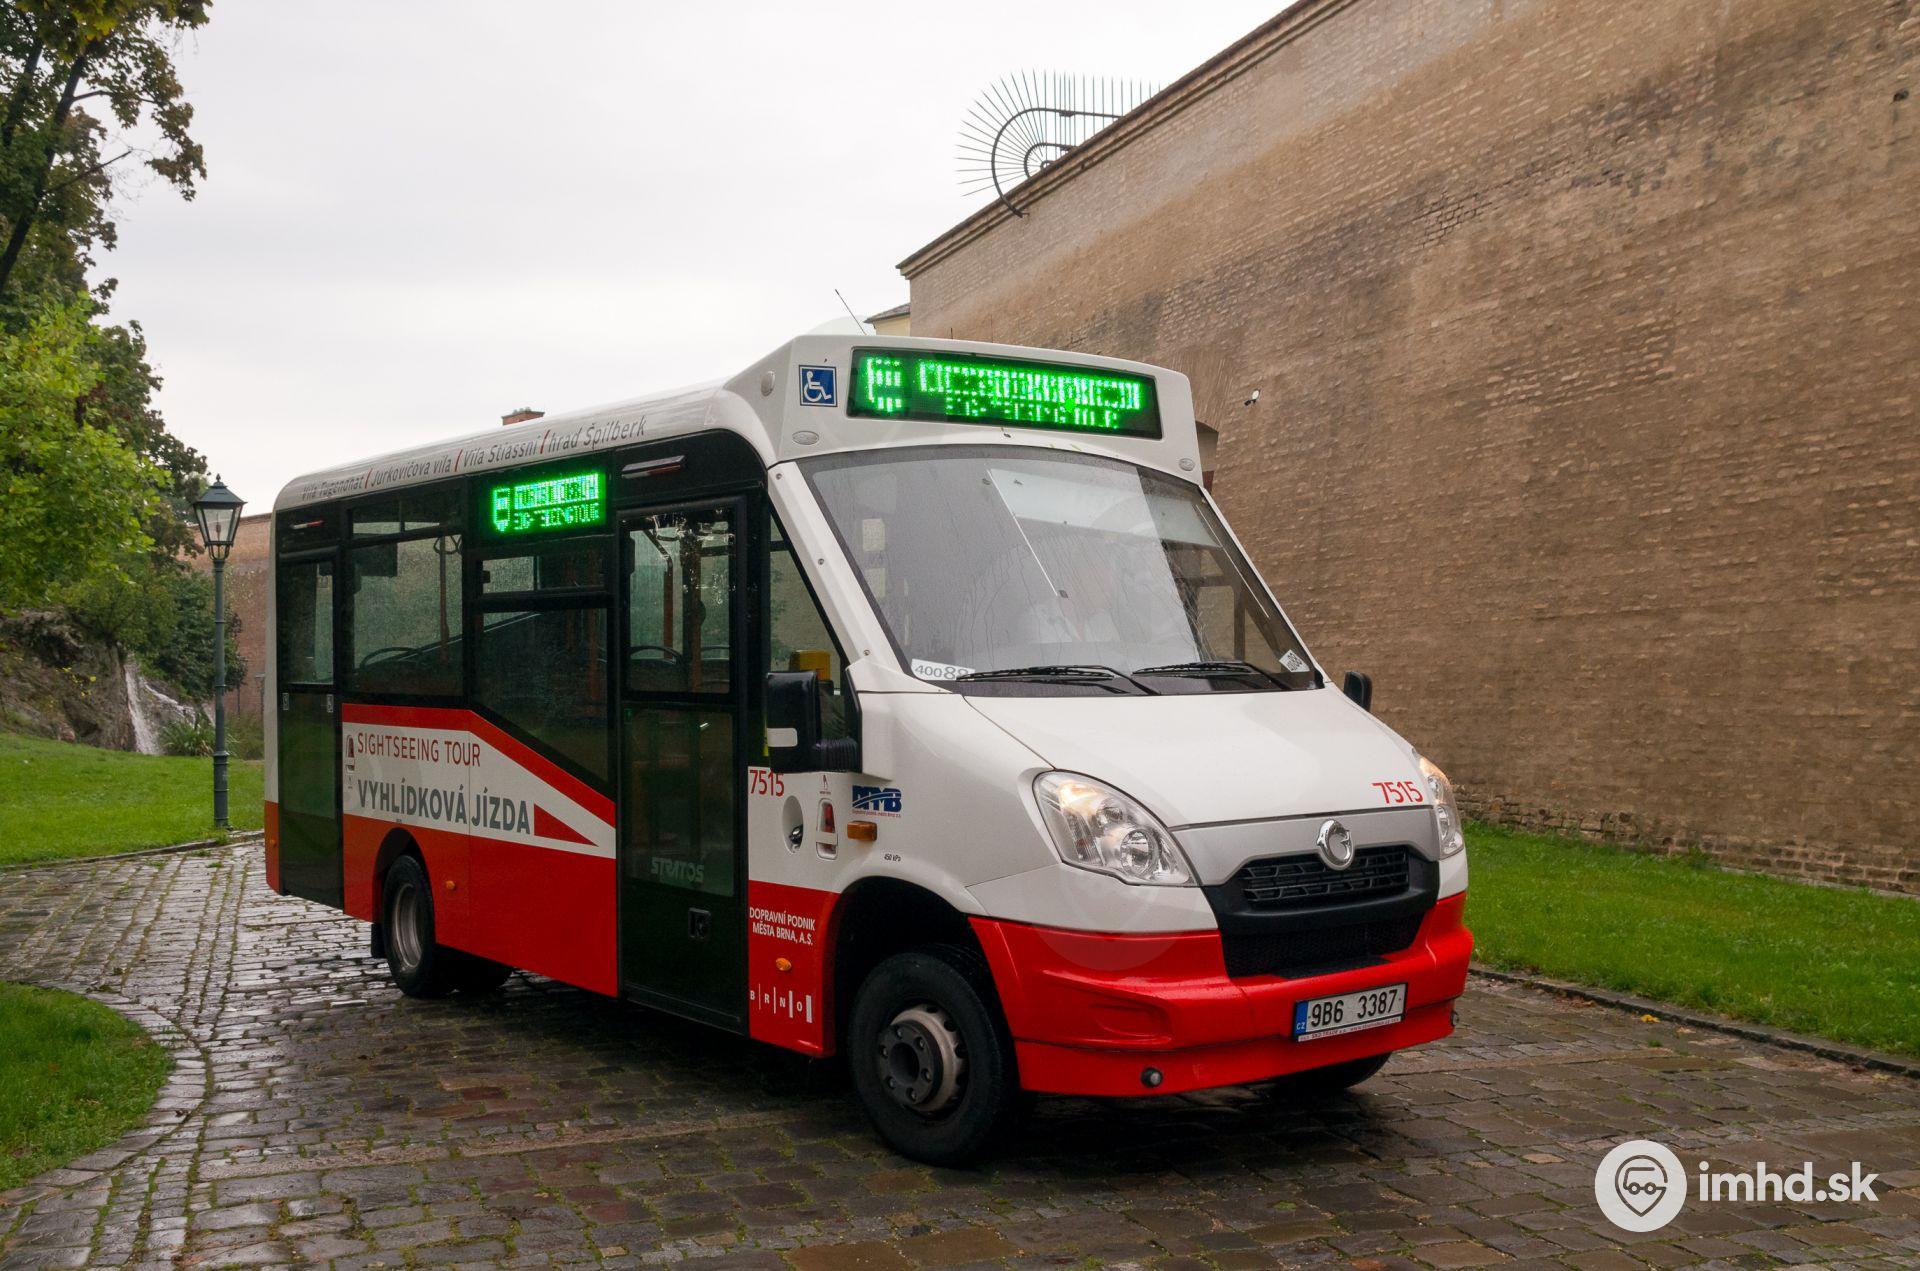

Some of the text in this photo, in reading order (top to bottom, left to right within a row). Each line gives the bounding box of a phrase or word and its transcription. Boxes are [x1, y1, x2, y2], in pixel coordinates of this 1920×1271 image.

[433, 455, 452, 474] vila
[463, 447, 484, 467] Vila
[548, 427, 583, 452] hrad
[583, 415, 647, 449] Špilberk
[357, 732, 481, 767] SIGHTSEEING TOUR
[750, 769, 785, 797] 7515
[1371, 781, 1423, 804] 7515
[357, 777, 531, 835] VYHLÍDKOVÁ JÍZDA
[749, 907, 816, 931] DOPRAVNÍ PODNIK
[752, 920, 814, 946] MĚSTA BRNA, A.S.
[1310, 1000, 1345, 1027] 9B6
[1357, 989, 1398, 1019] 3387
[1296, 1022, 1306, 1030] CZ
